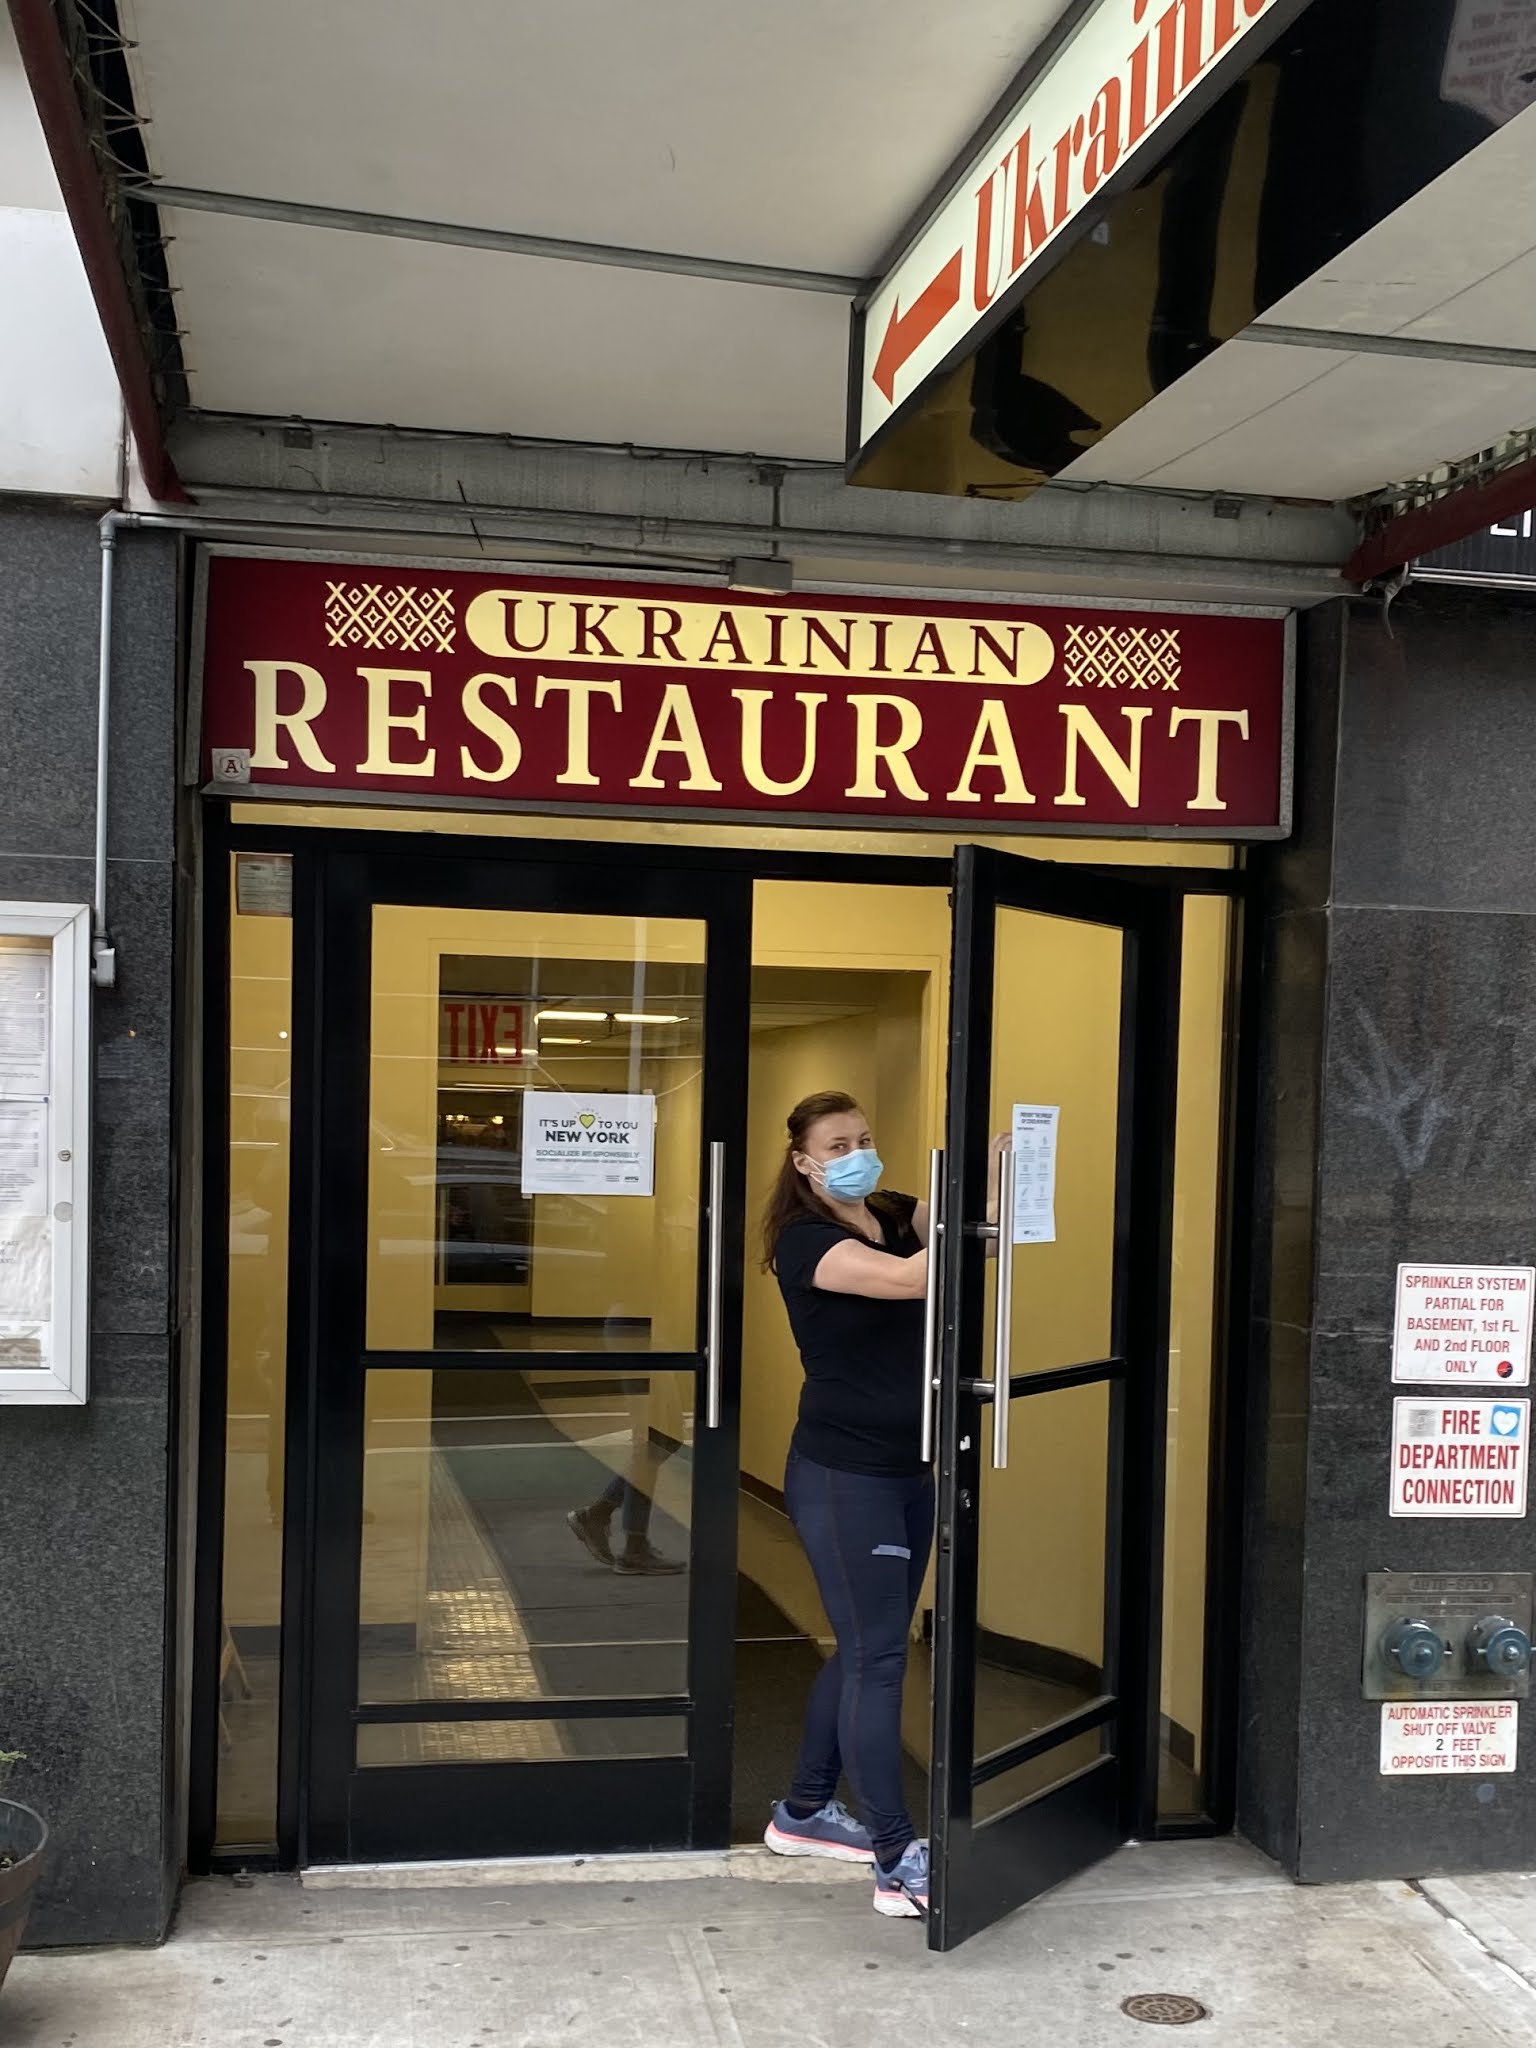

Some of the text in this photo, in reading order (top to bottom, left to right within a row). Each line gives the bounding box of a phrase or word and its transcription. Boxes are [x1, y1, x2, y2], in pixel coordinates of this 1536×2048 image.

[974, 0, 1268, 312] Ukrain
[498, 598, 1025, 678] UKRAINIAN
[243, 660, 1250, 810] RESTAURANT
[539, 1119, 639, 1130] IT'S UP TO YOU
[545, 1130, 630, 1144] NEW YORK
[582, 1150, 640, 1158] RESPONSIBLY
[1405, 1275, 1526, 1291] SPRINKLER SYSTEM
[1425, 1297, 1504, 1311] PARTIAL FOR
[1407, 1317, 1477, 1333] BASEMENT,
[1482, 1320, 1499, 1332] 1st
[1414, 1339, 1510, 1353] AND 2nd FLOOR
[1445, 1360, 1478, 1373] ONLY
[1442, 1409, 1480, 1434] FIRE
[1400, 1444, 1520, 1469] DEPARTMENT
[1403, 1479, 1515, 1504] CONNECTION
[1388, 1705, 1512, 1720] AUTOMATIC SPRINKLER
[1403, 1721, 1496, 1736] SHUT OFF VALVE
[1436, 1738, 1481, 1751] 2 FEET
[1392, 1754, 1506, 1768] OPPOSITE THIS SIGN
